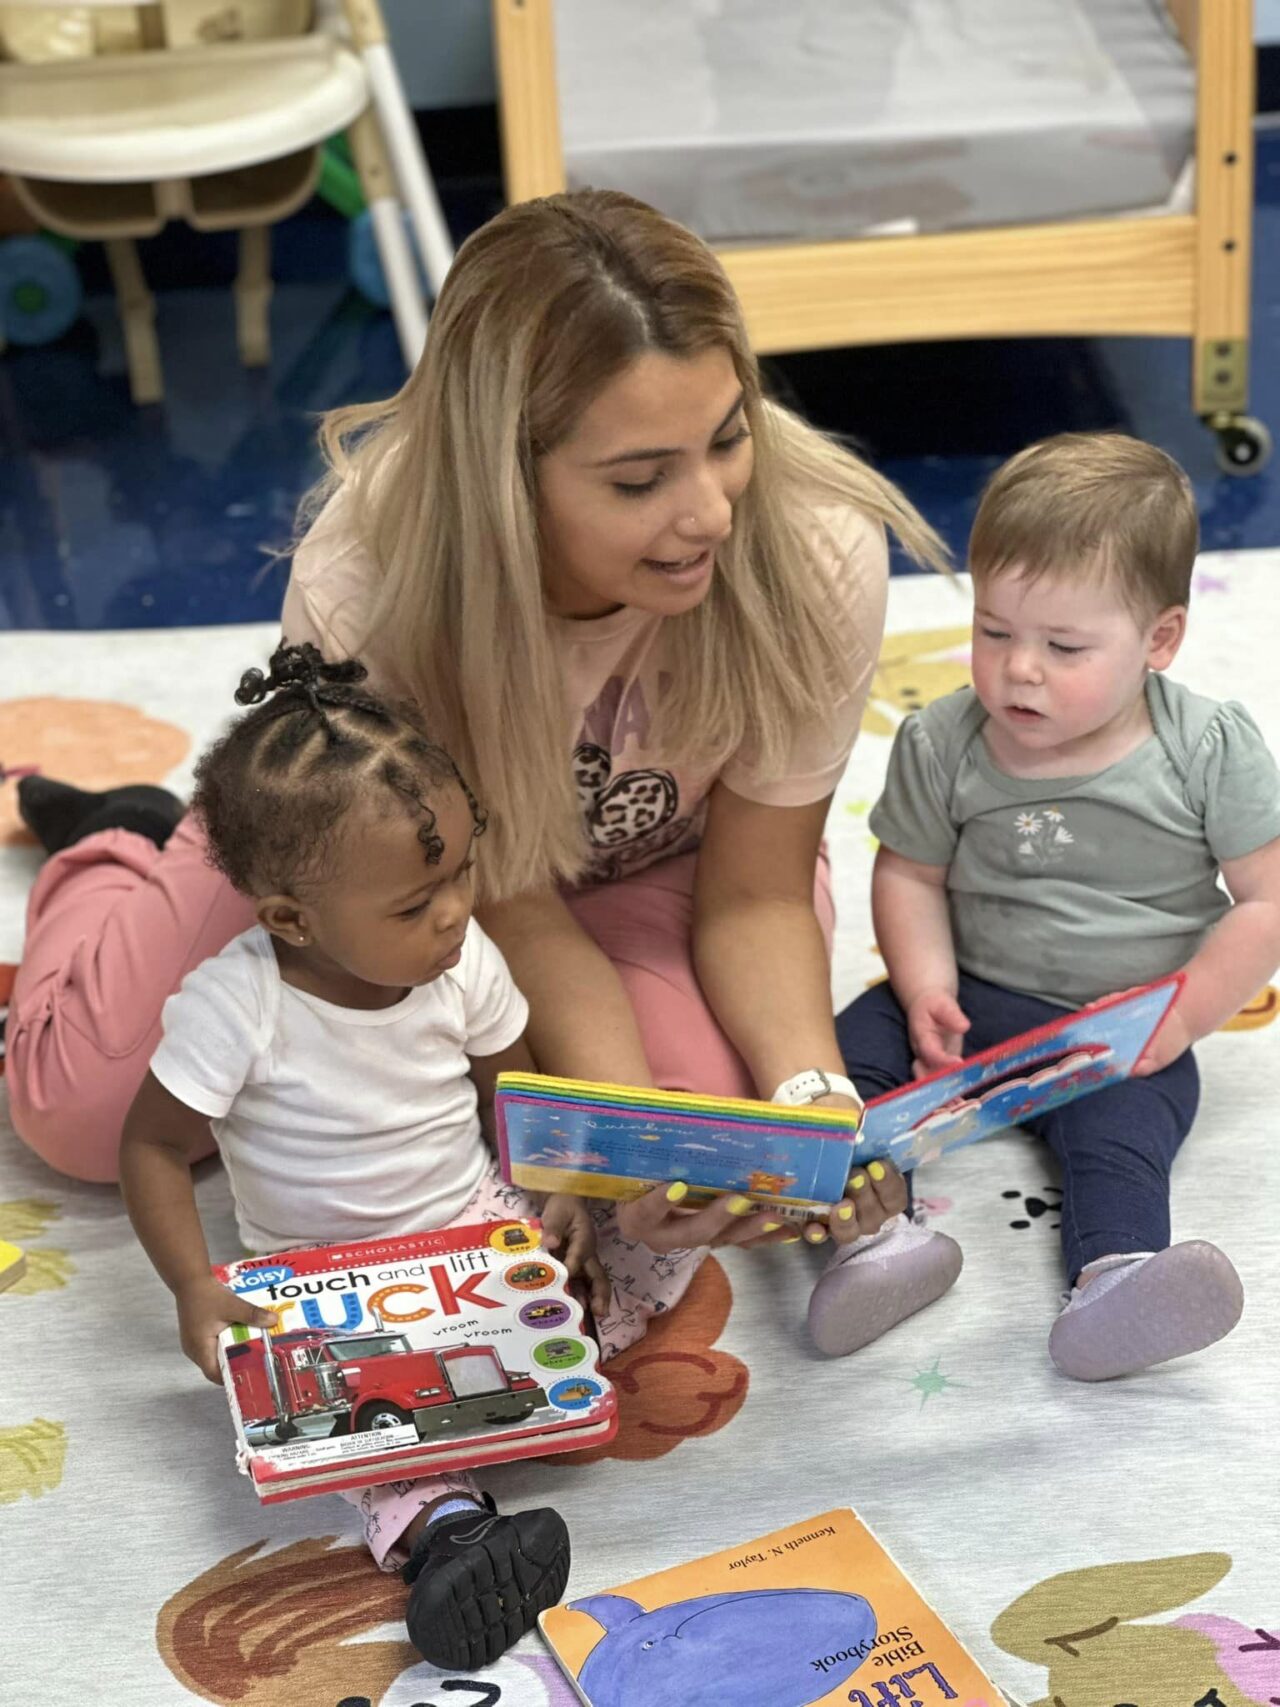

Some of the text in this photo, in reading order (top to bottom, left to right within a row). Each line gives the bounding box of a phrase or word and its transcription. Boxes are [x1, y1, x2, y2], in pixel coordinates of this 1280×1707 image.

[345, 1238, 442, 1259] SCHOLASTIC
[230, 1268, 287, 1291] Noisy
[267, 1251, 489, 1301] touch and lift
[433, 1319, 479, 1336] vroom
[464, 1327, 513, 1339] vroom
[350, 1431, 383, 1441] ATTENTION
[728, 1526, 837, 1571] Kenneth N. Taylor
[808, 1625, 914, 1674] Storybook
[871, 1640, 926, 1668] Bible
